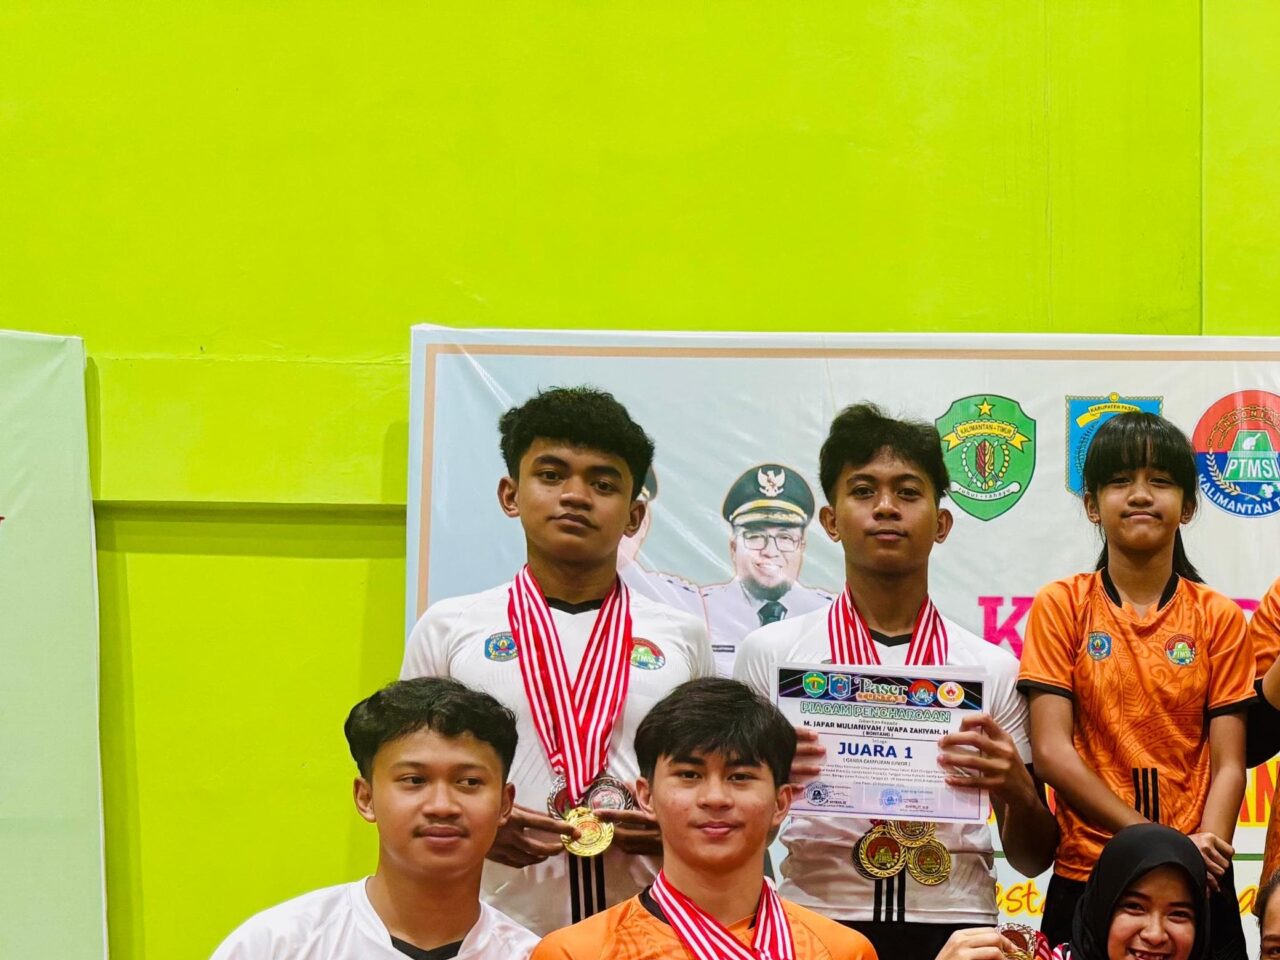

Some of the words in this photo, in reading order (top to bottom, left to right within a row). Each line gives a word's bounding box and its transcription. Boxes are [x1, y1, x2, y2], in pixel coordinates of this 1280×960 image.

[1225, 458, 1280, 478] PTMSI
[1198, 473, 1273, 514] KALIMANTAN
[854, 677, 908, 697] Paser
[801, 701, 852, 716] PIAGAM
[852, 705, 951, 722] PENGHARGAAN
[838, 742, 897, 758] JUARA
[904, 747, 913, 758] 1
